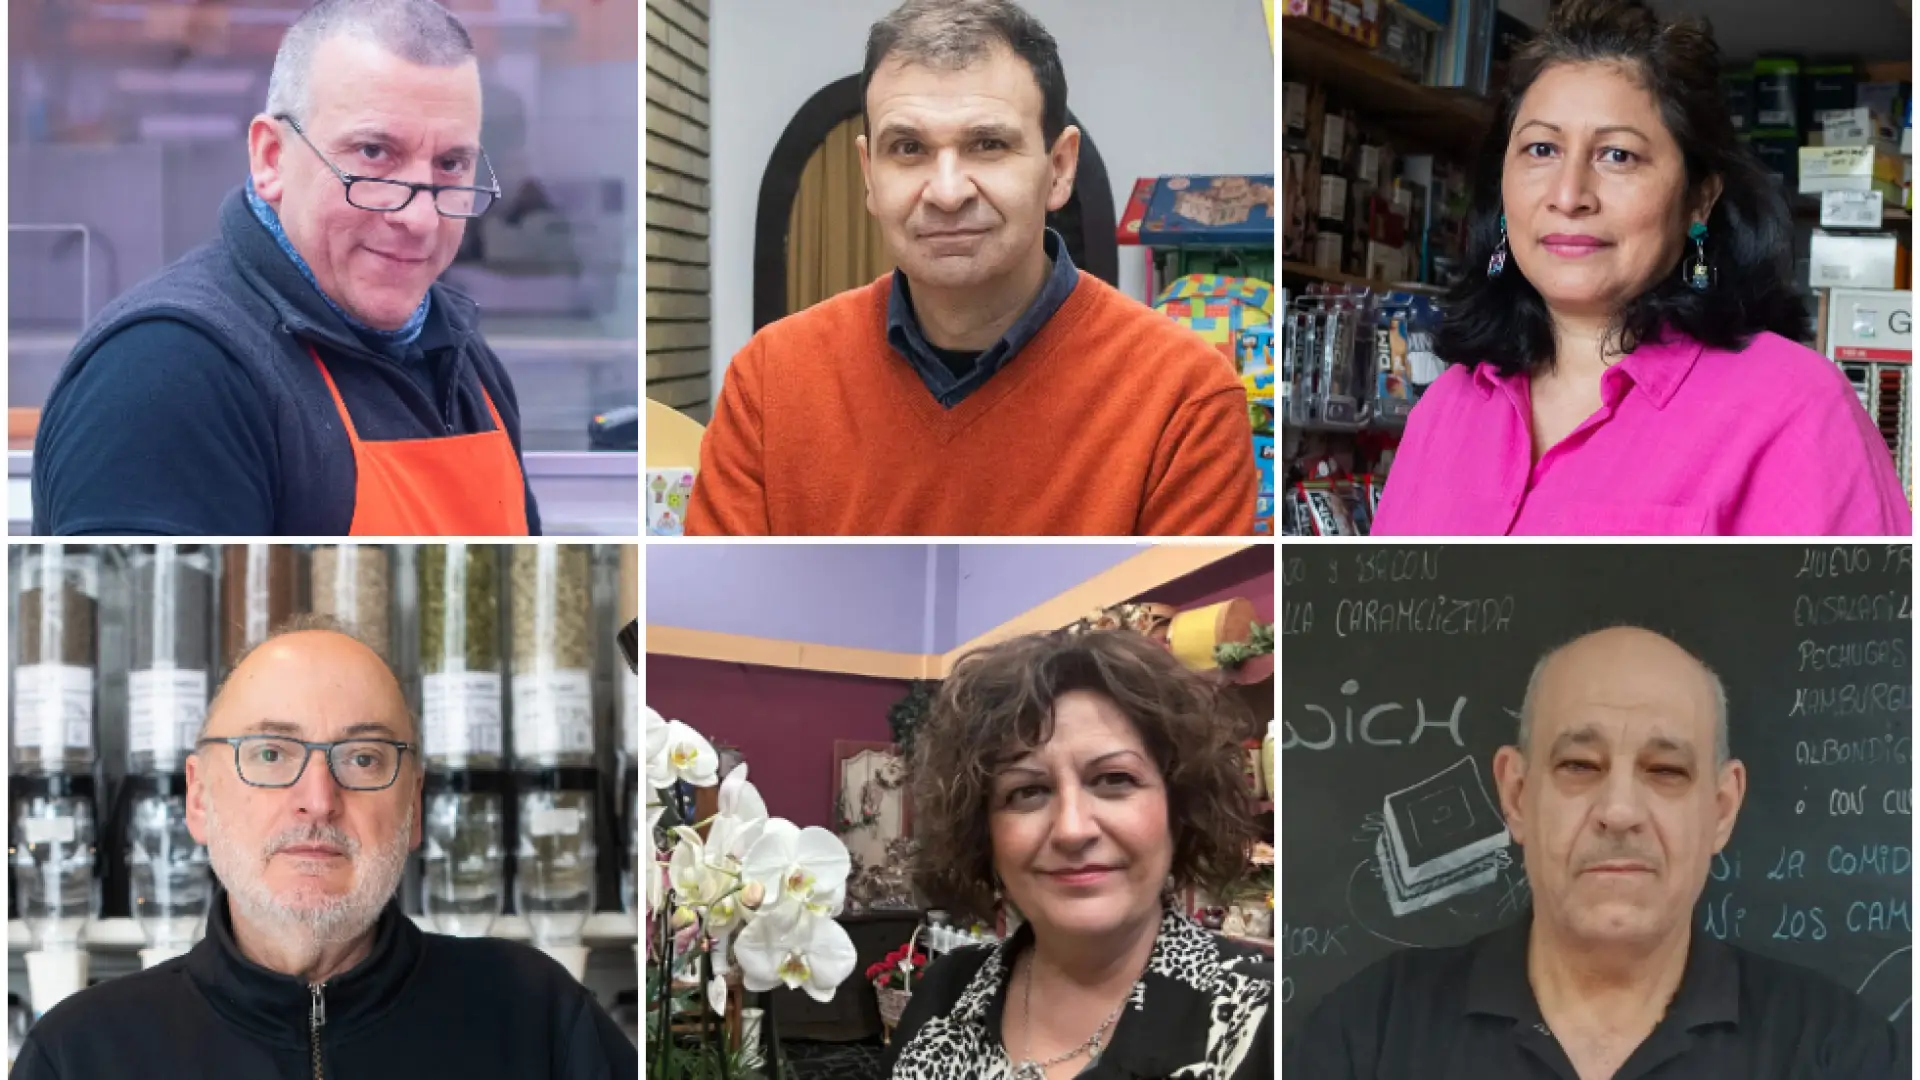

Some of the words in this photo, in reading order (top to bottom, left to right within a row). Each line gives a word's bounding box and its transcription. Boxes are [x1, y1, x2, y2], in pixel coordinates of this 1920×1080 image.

[1378, 330, 1390, 369] DIM
[1355, 545, 1444, 583] BACON
[1794, 546, 1870, 578] HUEVO
[1796, 733, 1912, 765] ALBONDiG
[1830, 785, 1867, 816] CON
[1766, 847, 1805, 880] LA
[1772, 903, 1828, 940] LOS
